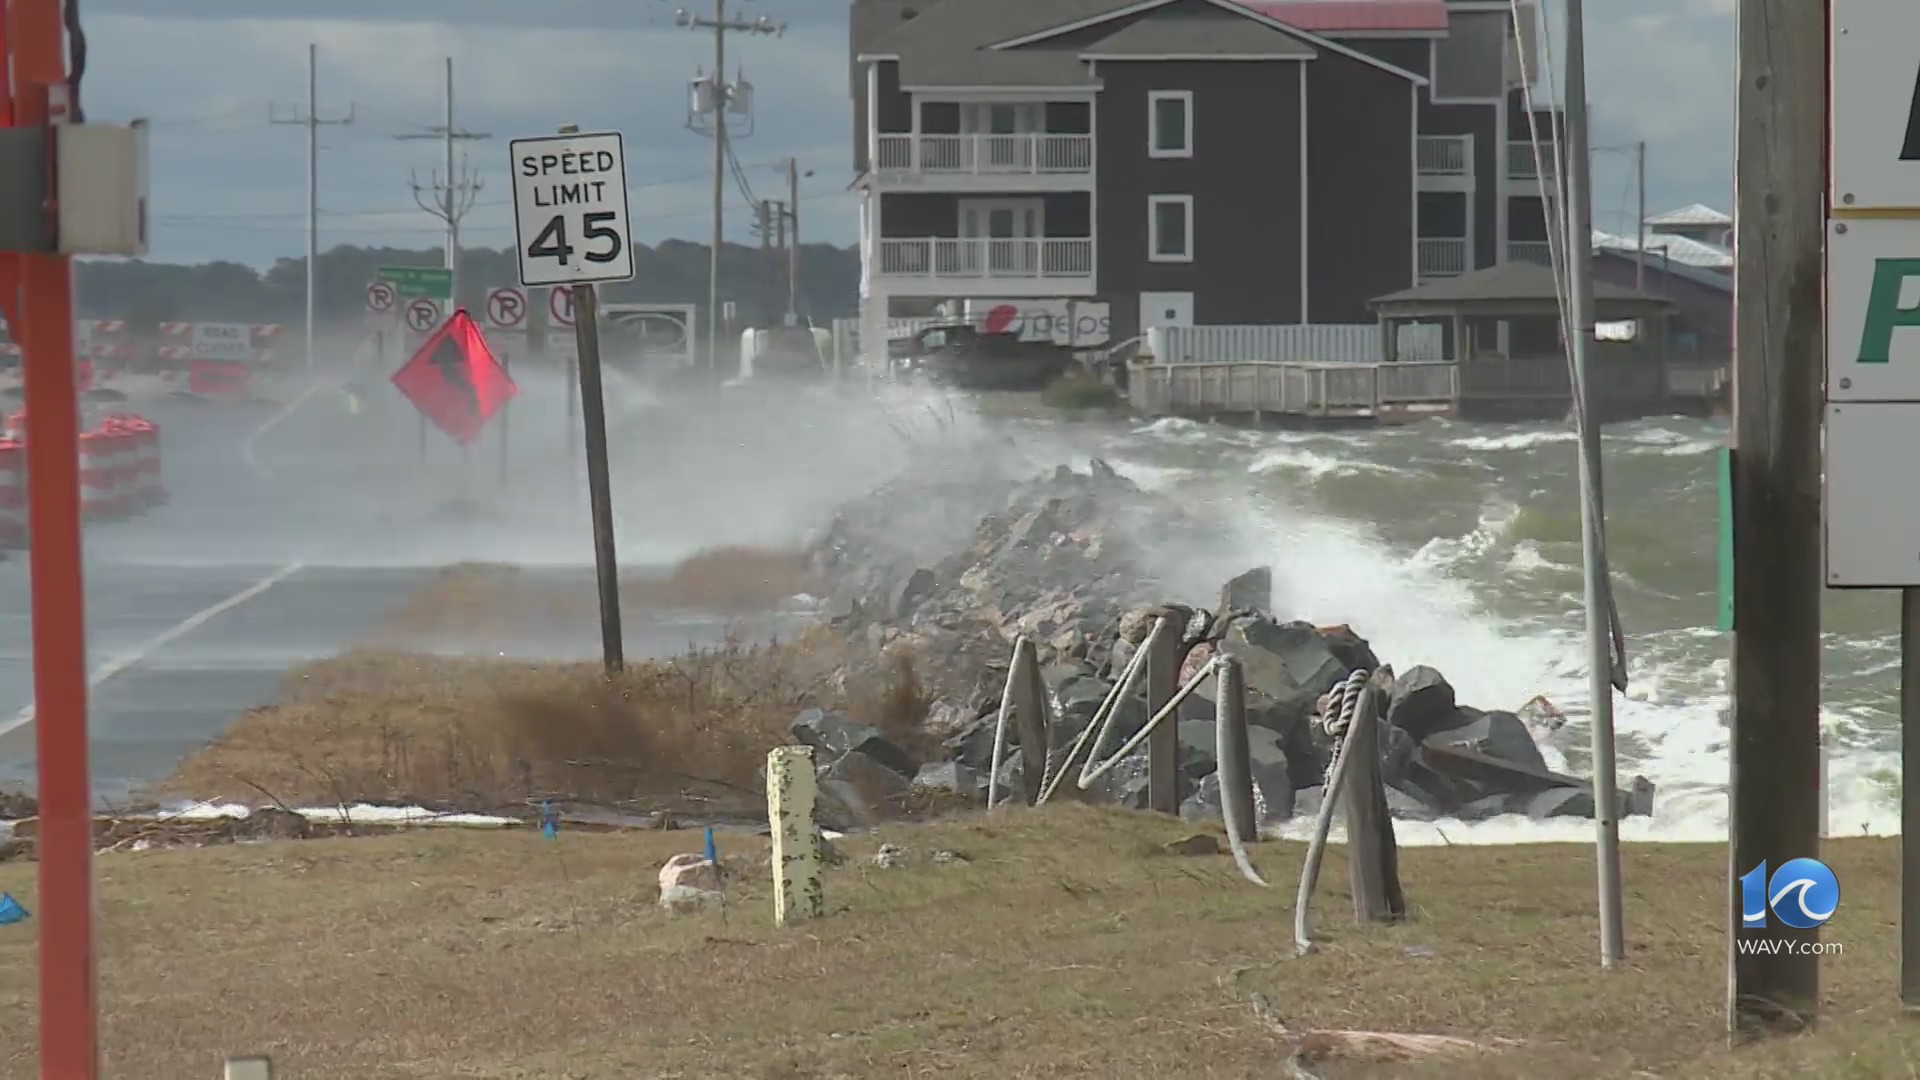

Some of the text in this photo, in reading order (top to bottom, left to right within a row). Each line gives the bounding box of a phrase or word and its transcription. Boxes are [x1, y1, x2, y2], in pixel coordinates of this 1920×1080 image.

[522, 150, 614, 177] SPEED
[534, 181, 606, 207] LIMIT
[528, 211, 622, 266] 45
